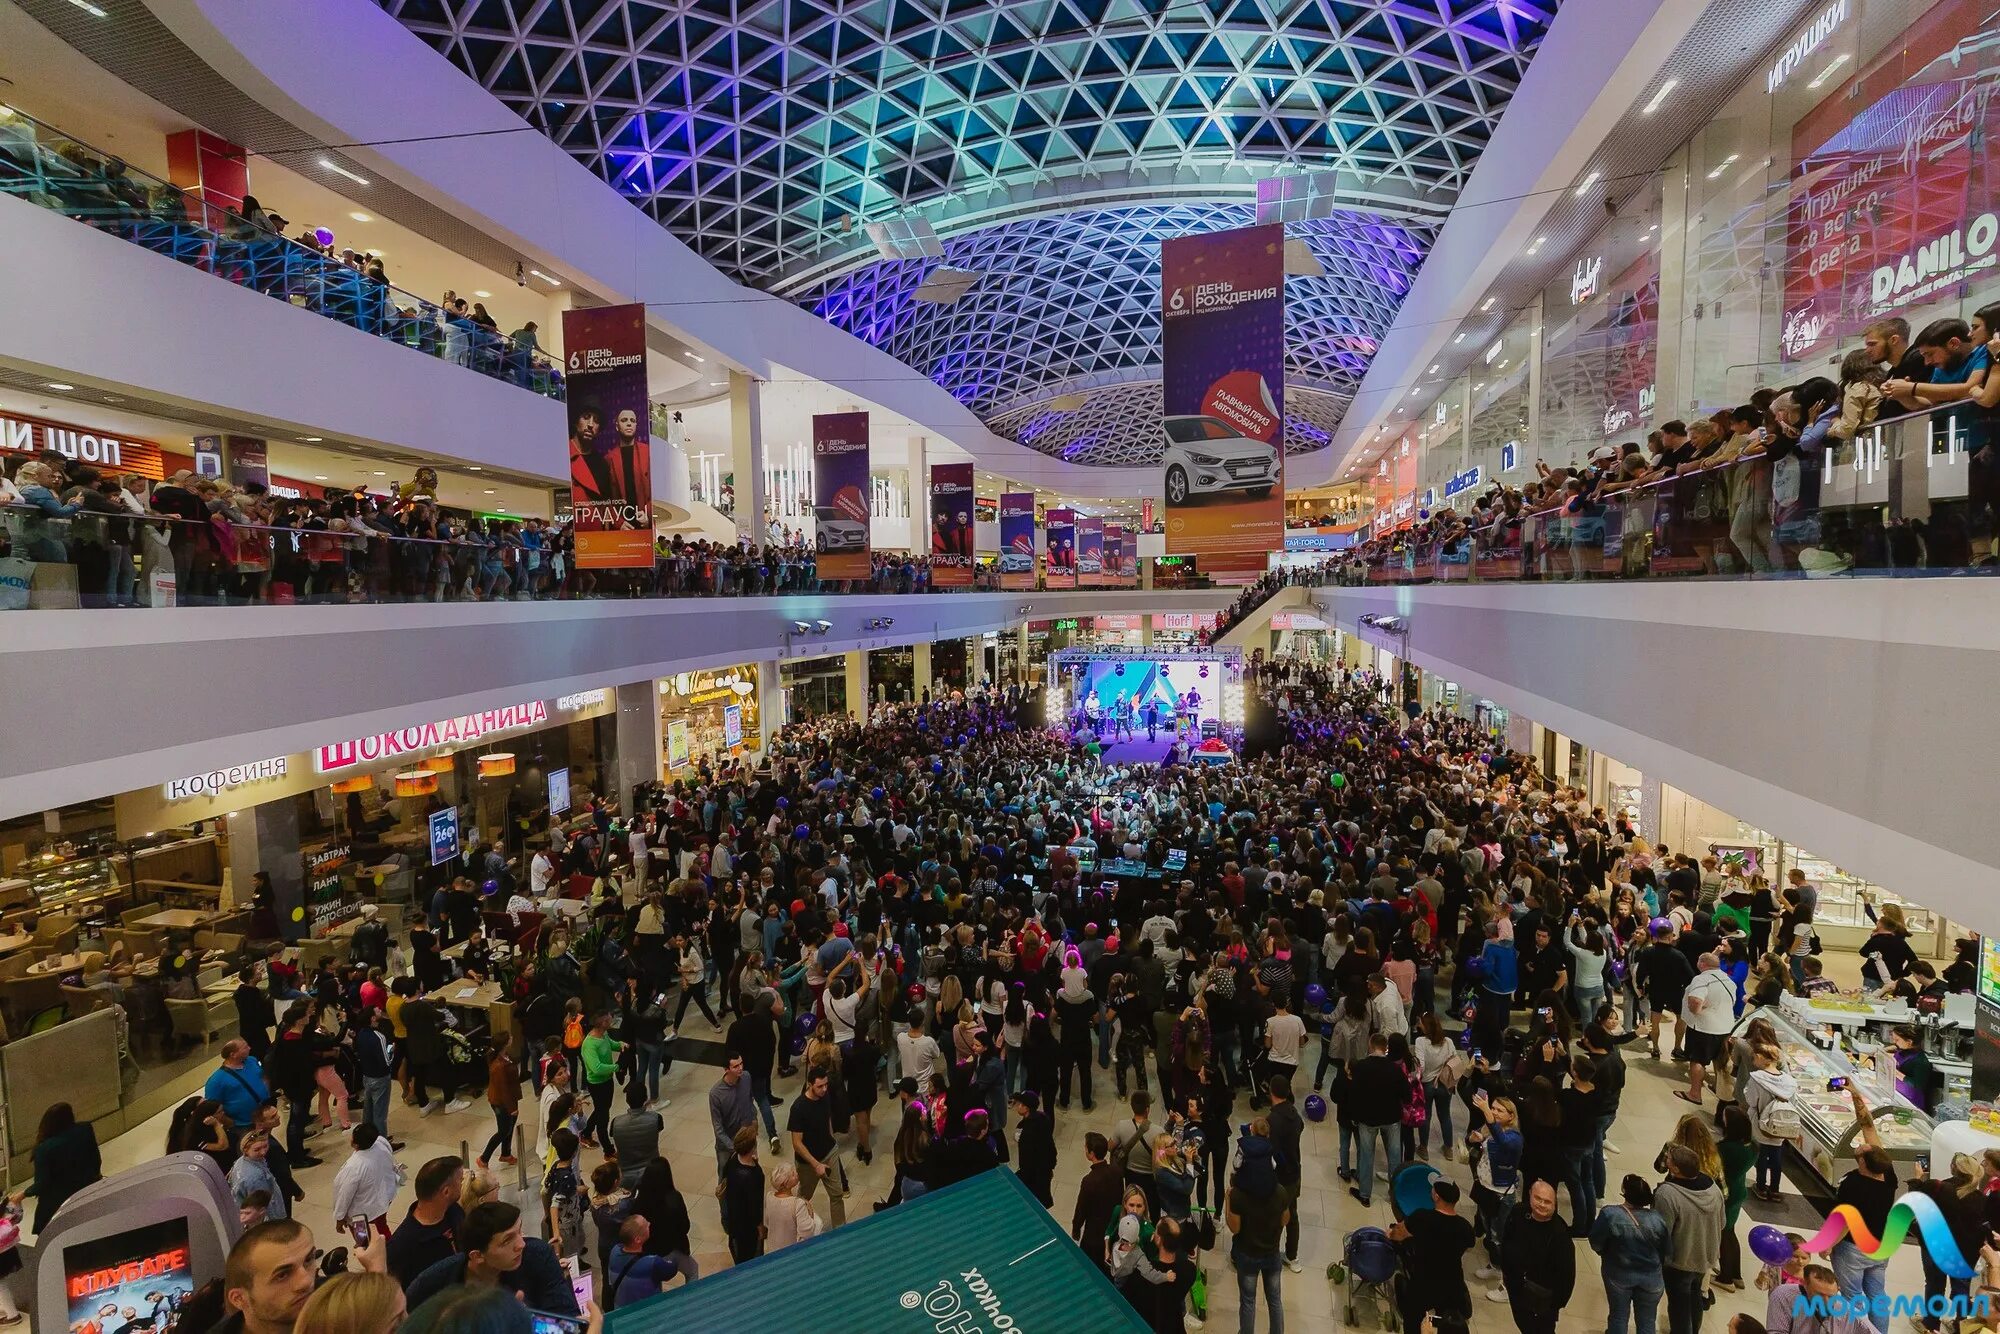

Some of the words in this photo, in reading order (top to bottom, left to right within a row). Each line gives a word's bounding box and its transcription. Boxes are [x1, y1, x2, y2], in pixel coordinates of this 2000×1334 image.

[1768, 0, 1845, 94] ИГРУШКИ
[1872, 213, 1998, 304] DANILO
[1169, 288, 1184, 310] 6
[1196, 282, 1233, 296] ДЕНЬ
[1195, 287, 1277, 307] РОЖДЕНИЯ
[569, 351, 580, 369] 6
[587, 348, 612, 358] ДЕНЬ
[587, 354, 642, 368] РОЖДЕНИЯ
[1211, 400, 1261, 435] АВТОМОБИЛЬ
[1216, 389, 1251, 415] ГЛАВНЫЙ
[1249, 409, 1270, 427] ПРИЗ
[0, 418, 34, 451] И
[829, 443, 867, 452] РОЖДЕНИЯ
[574, 504, 649, 525] ГРАДУСЫ
[1284, 538, 1326, 547] ТАЙ-ГОРОД
[932, 555, 973, 565] ГРАДУСЫ
[318, 700, 548, 773] ШОКОЛАДНИЦА
[312, 845, 351, 866] ЗАВТРАК
[313, 874, 339, 891] ЛАНЧ
[314, 898, 342, 916] УЖИН
[71, 1249, 186, 1298] КЛУБАРЕ
